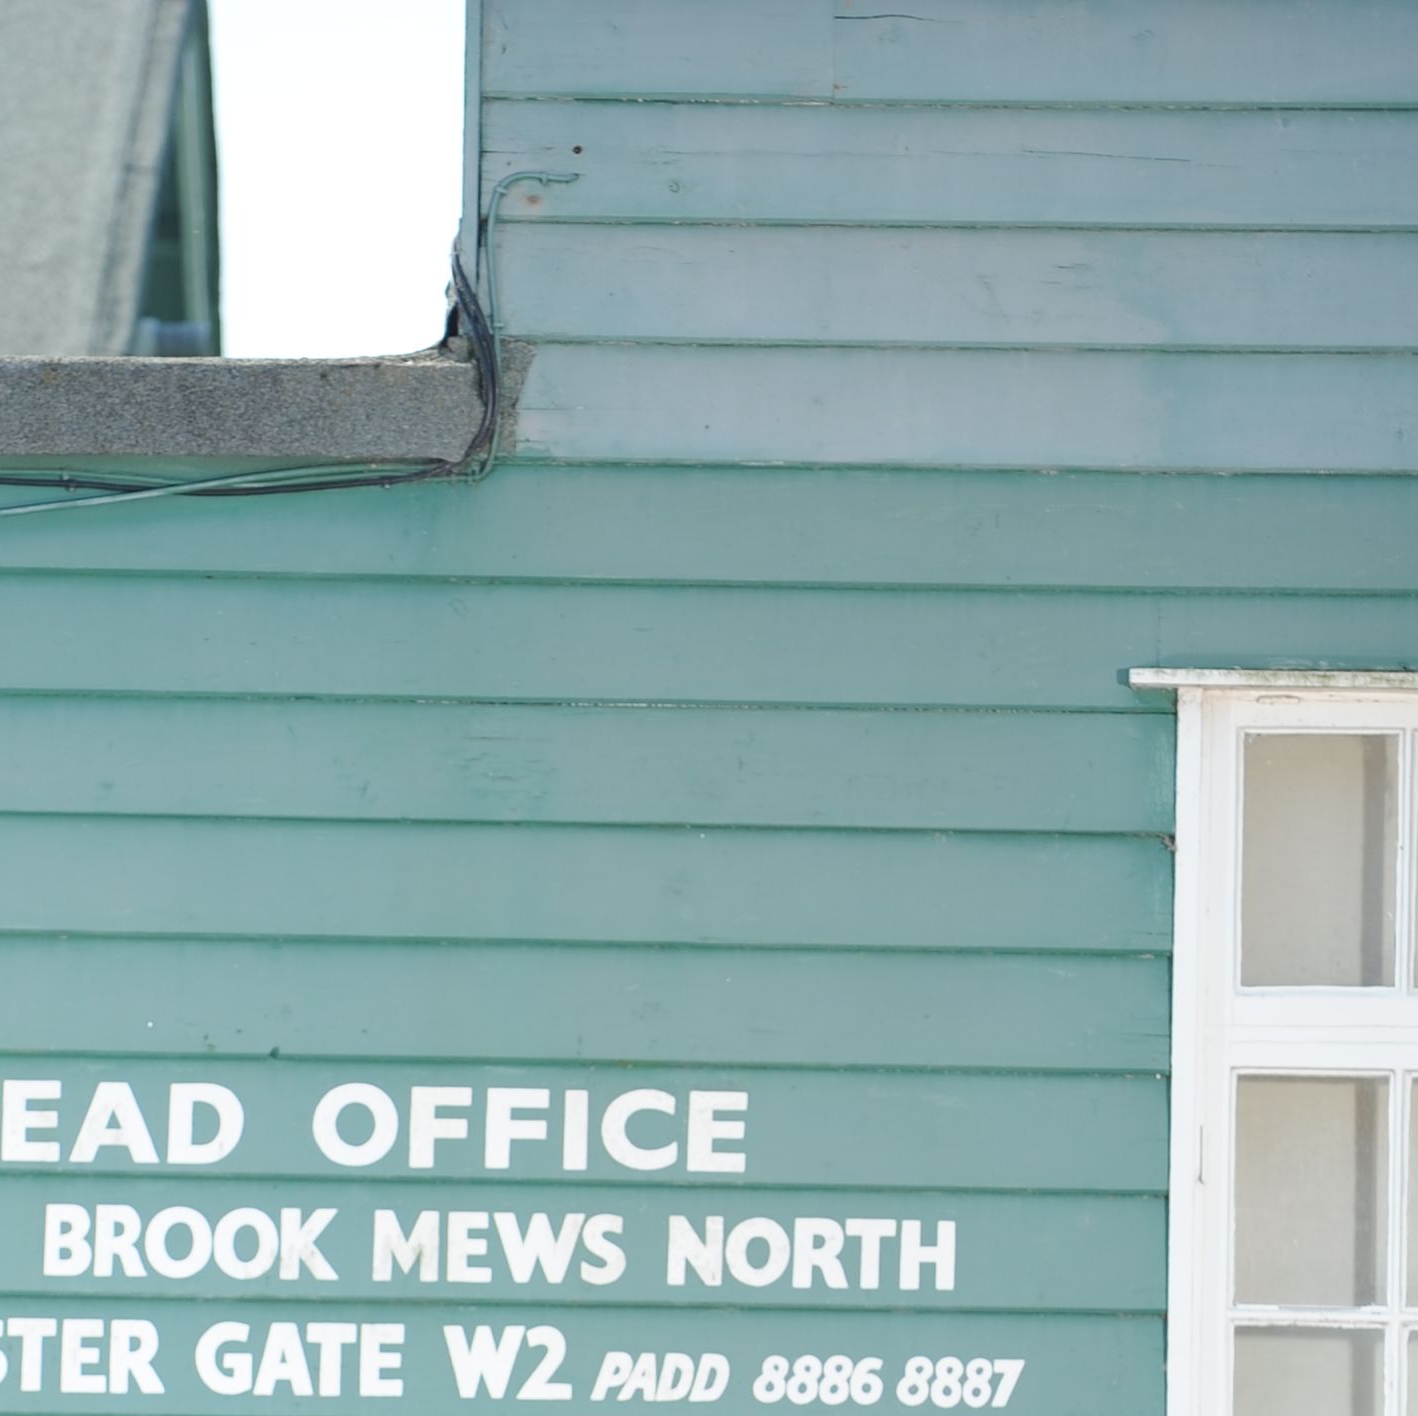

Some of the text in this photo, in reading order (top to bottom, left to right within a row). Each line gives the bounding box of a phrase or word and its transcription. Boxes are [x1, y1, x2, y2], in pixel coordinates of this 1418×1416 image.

[312, 1082, 749, 1174] OFFICE
[42, 1203, 339, 1281] BROOK
[371, 1209, 627, 1285] MEWS
[666, 1215, 957, 1291] NORTH
[194, 1321, 406, 1398] GATE
[442, 1325, 573, 1400] W2
[589, 1350, 731, 1402] PADD
[752, 1354, 884, 1406] 8886
[895, 1356, 1026, 1409] 8887
